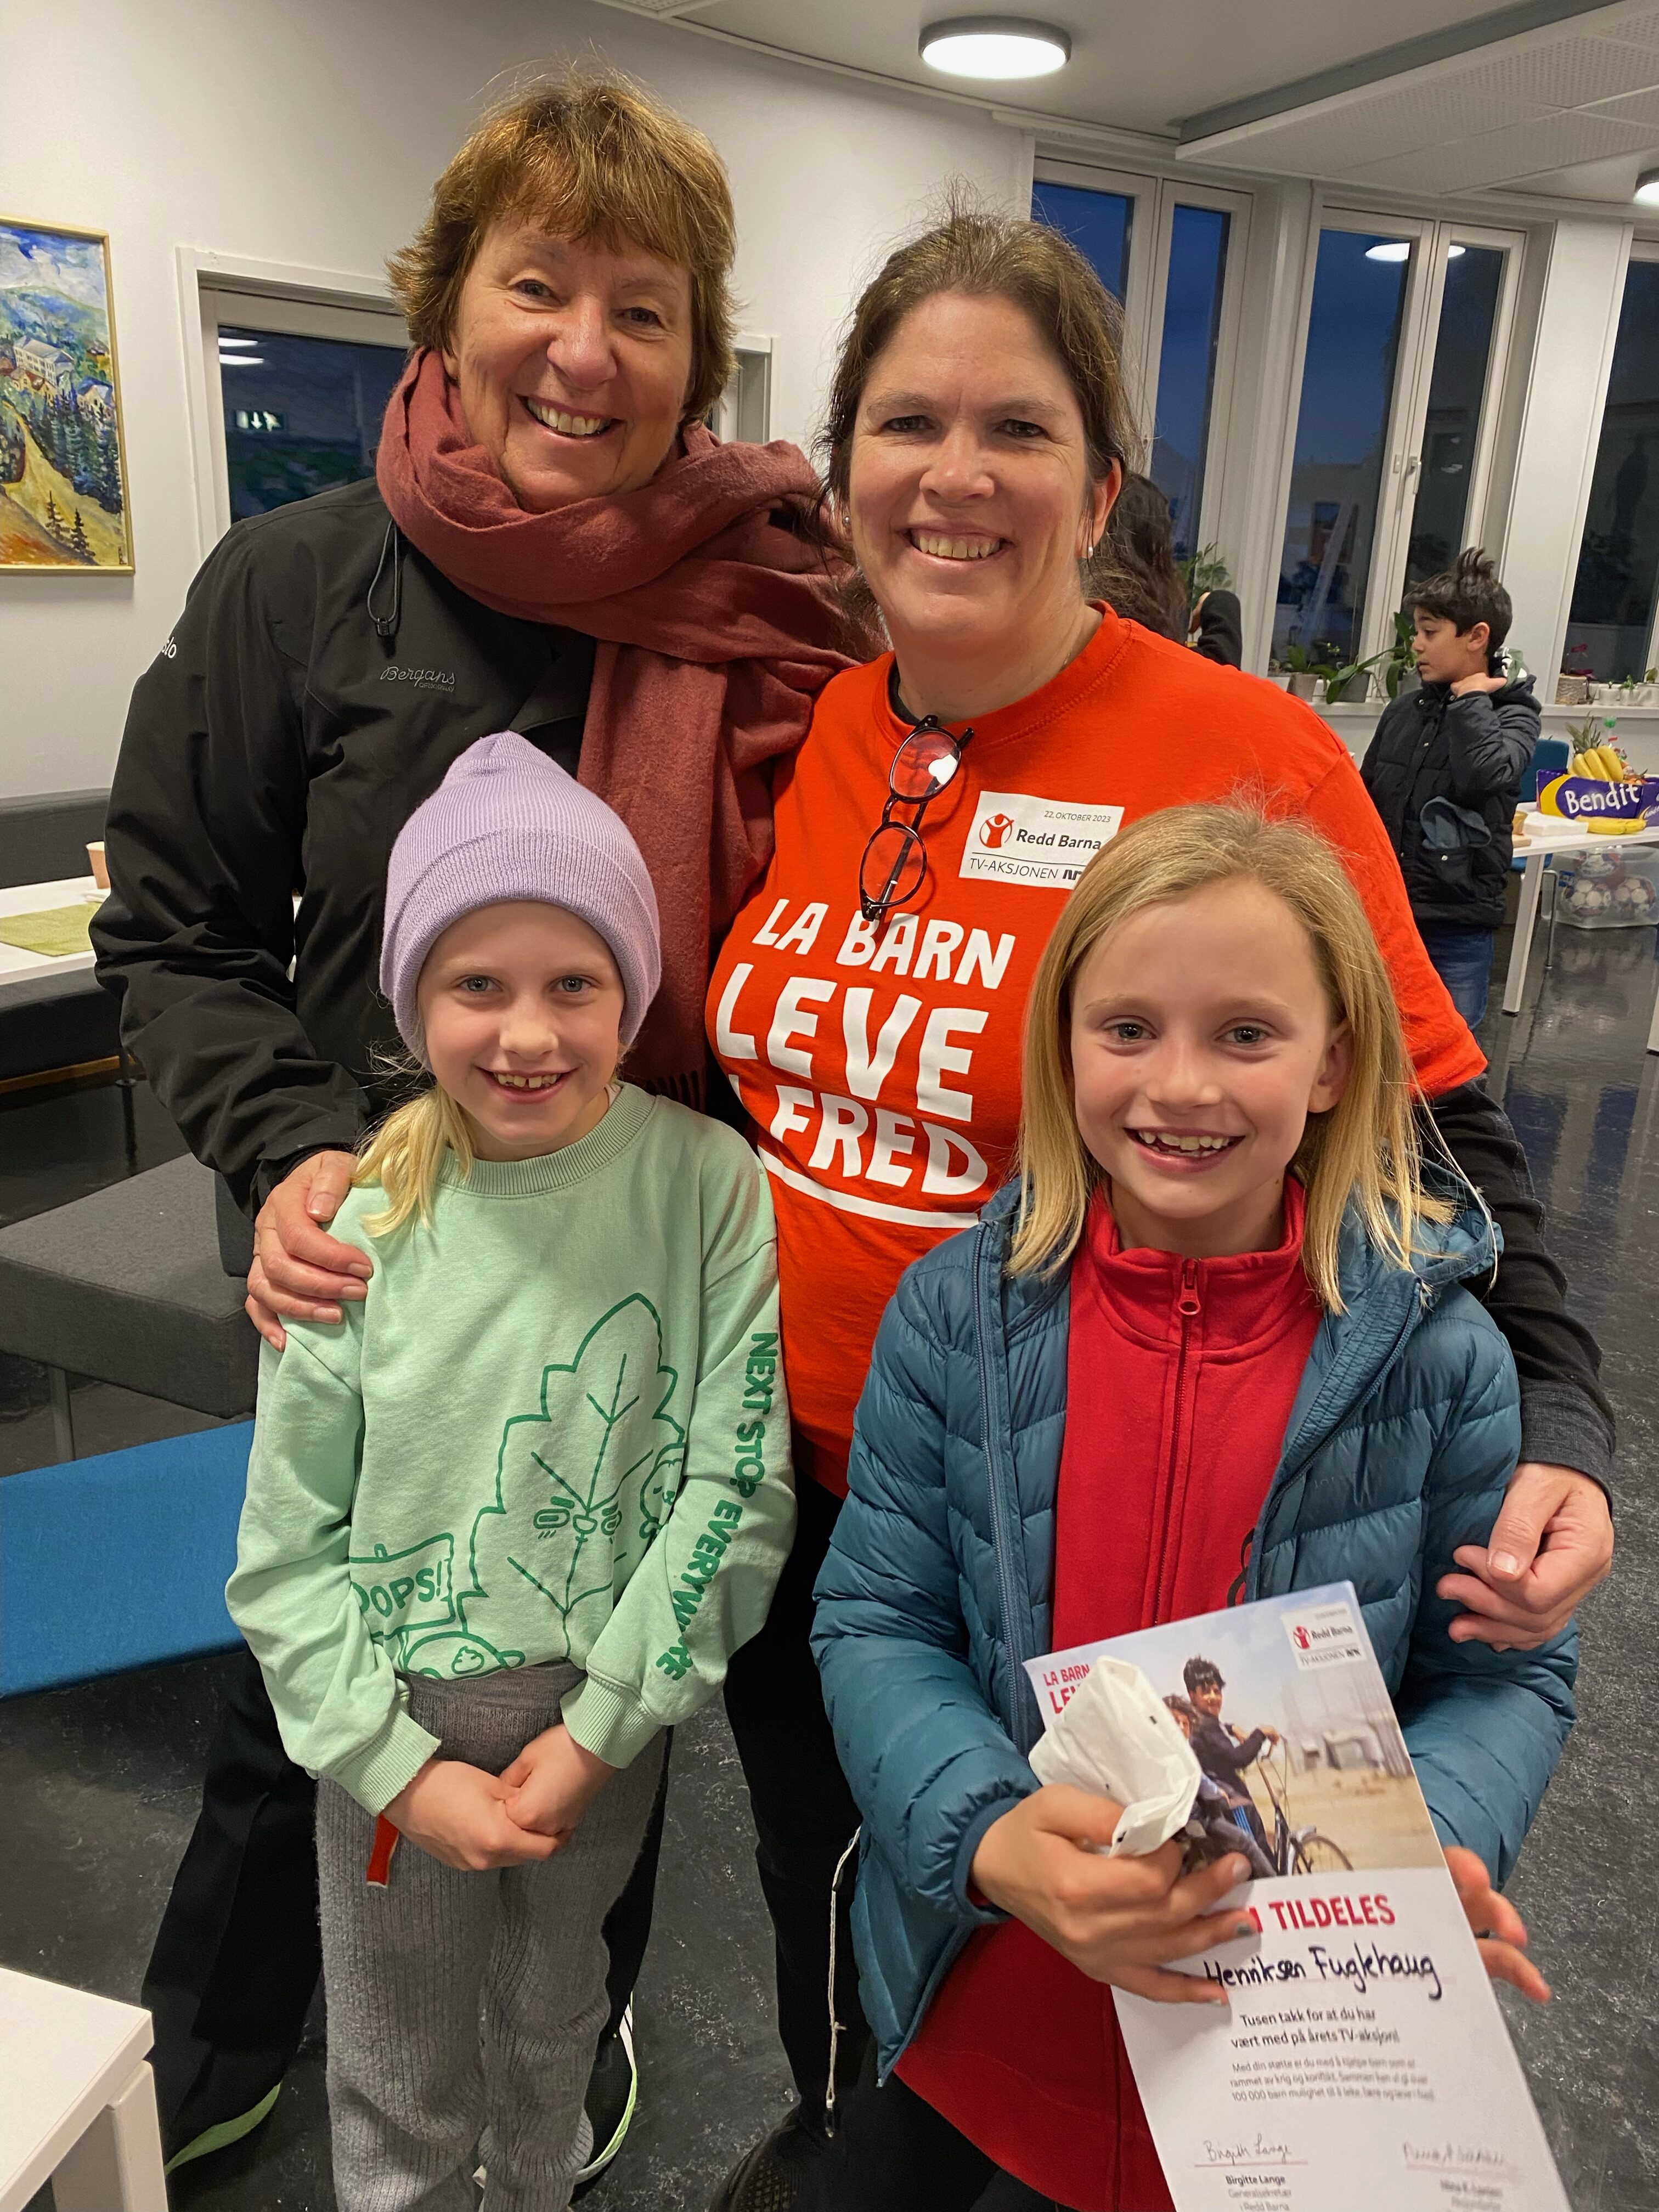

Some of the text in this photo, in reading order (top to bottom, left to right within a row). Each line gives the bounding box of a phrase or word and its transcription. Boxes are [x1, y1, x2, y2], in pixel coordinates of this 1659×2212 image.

[380, 666, 455, 687] Bergans
[1565, 782, 1640, 814] Bendit
[1056, 812, 1091, 821] OKTOBER
[1016, 828, 1102, 850] Redd Barna
[970, 857, 1083, 881] TV-AKSJONEN nr
[752, 898, 1016, 990] LA BARN
[716, 962, 989, 1123] LEVE
[770, 1085, 989, 1195] FRED
[656, 1332, 779, 1680] NEXT STOP EVERYWRE
[1043, 1663, 1090, 1686] LA BARN
[1268, 1893, 1396, 1930] TILDELES
[1203, 1940, 1442, 2001] Henriksen Fuglehaug
[1239, 2005, 1375, 2028] Tusen takk for at du har
[1231, 2034, 1261, 2049] vært
[1262, 2030, 1289, 2046] med
[1290, 2028, 1306, 2047] på
[1232, 2062, 1251, 2073] Med
[1232, 2090, 1247, 2102] 100
[1248, 2089, 1266, 2101] 000
[1225, 2175, 1286, 2187] Birgitte Lange
